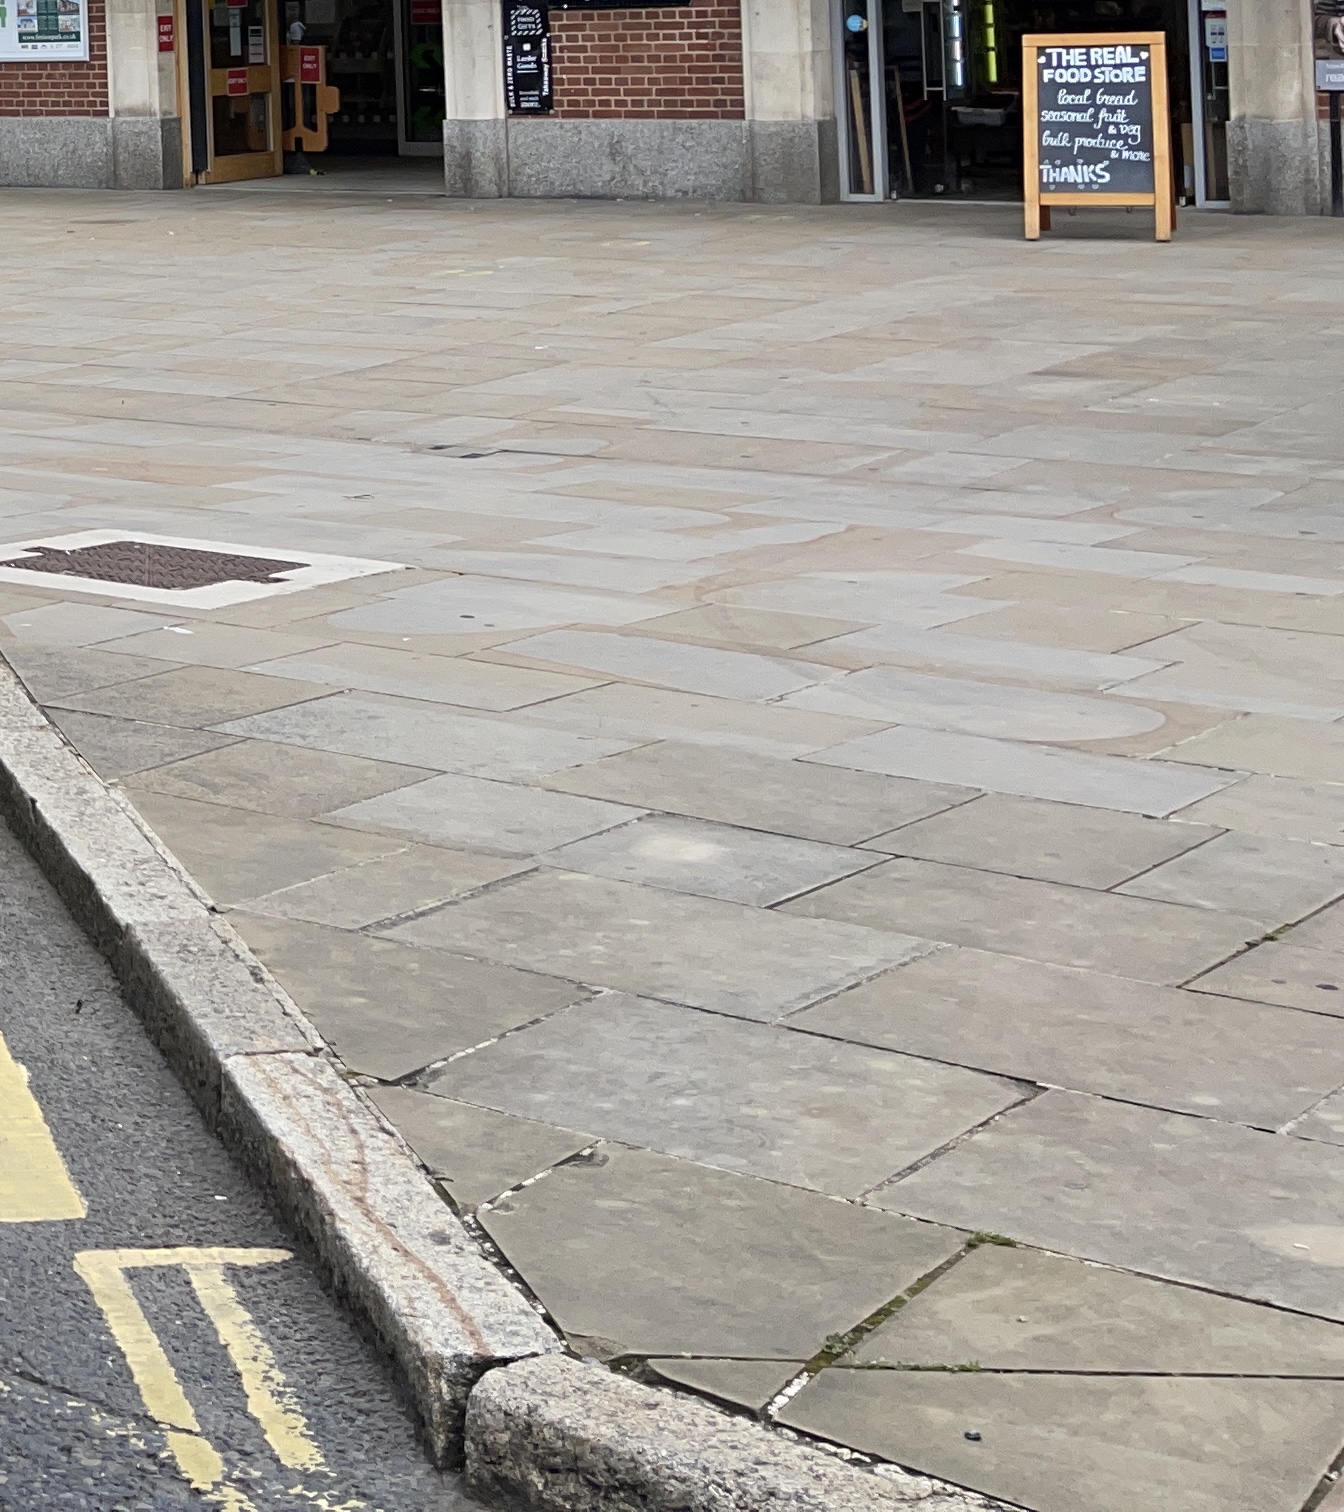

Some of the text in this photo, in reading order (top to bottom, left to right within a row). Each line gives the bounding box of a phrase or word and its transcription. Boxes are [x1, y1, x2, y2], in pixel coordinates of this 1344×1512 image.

[1045, 46, 1140, 67] THE REAL
[1043, 66, 1146, 83] FOOD STORE
[1057, 88, 1139, 105] local bread
[1040, 107, 1130, 129] seasonal fruit
[1042, 130, 1128, 155] bulk produce
[1119, 124, 1141, 145] veg
[1122, 150, 1150, 162] more
[1039, 160, 1111, 183] THANKS
